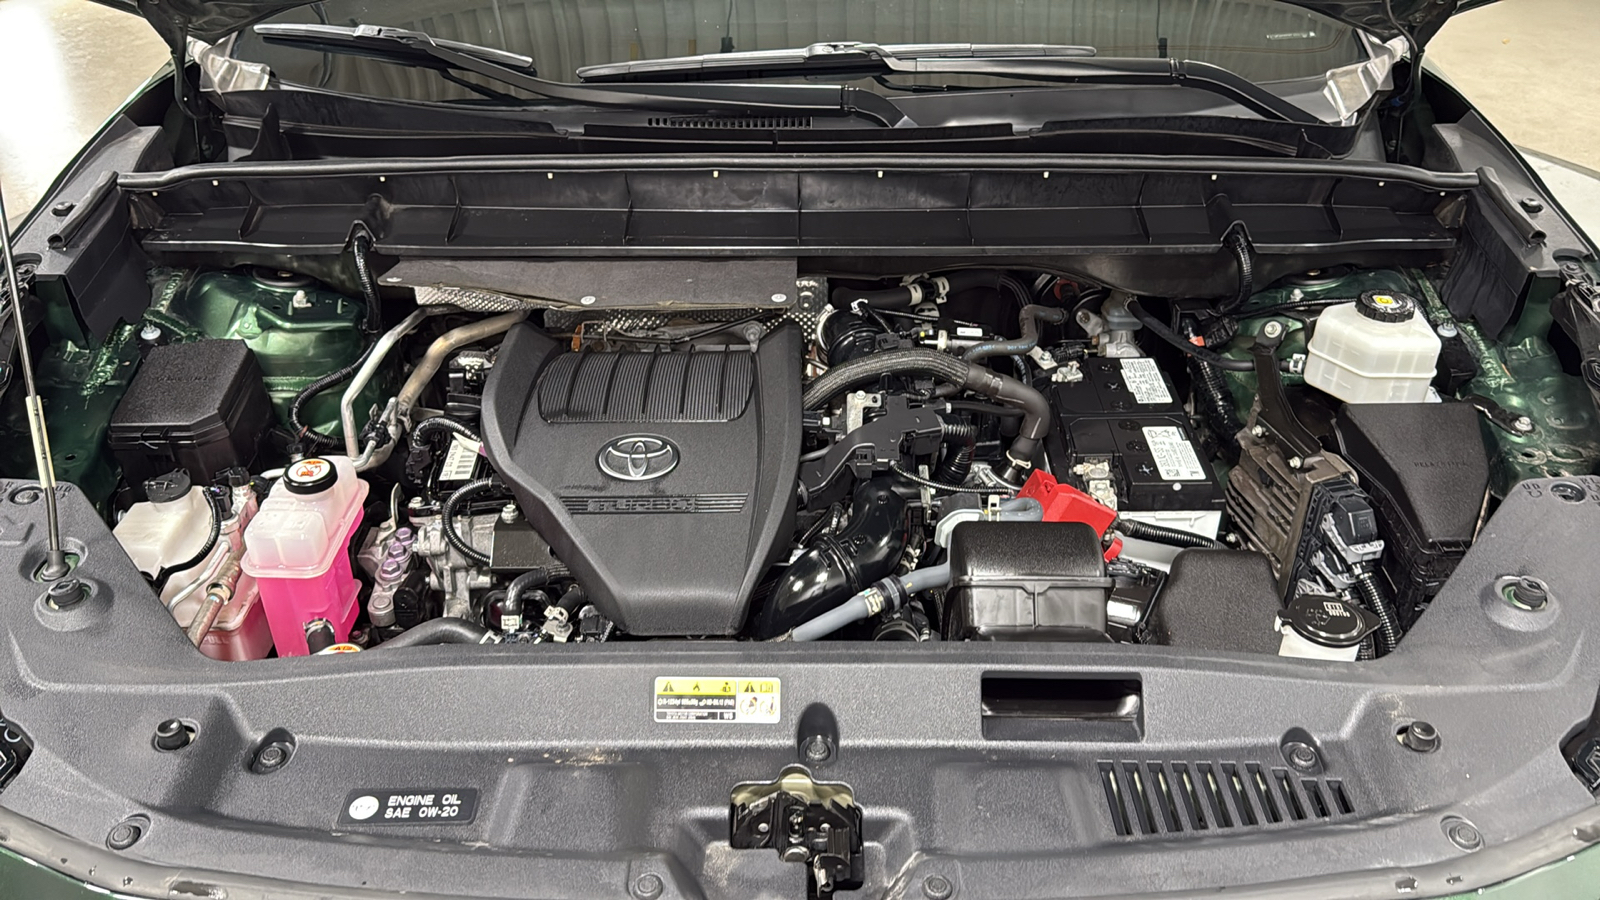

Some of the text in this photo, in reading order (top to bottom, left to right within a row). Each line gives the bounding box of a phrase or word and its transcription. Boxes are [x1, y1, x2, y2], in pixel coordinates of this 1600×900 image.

[588, 499, 696, 512] TURBO
[387, 794, 435, 807] ENGINE
[441, 794, 462, 805] OIL
[384, 806, 459, 818] SAE 0W-20
